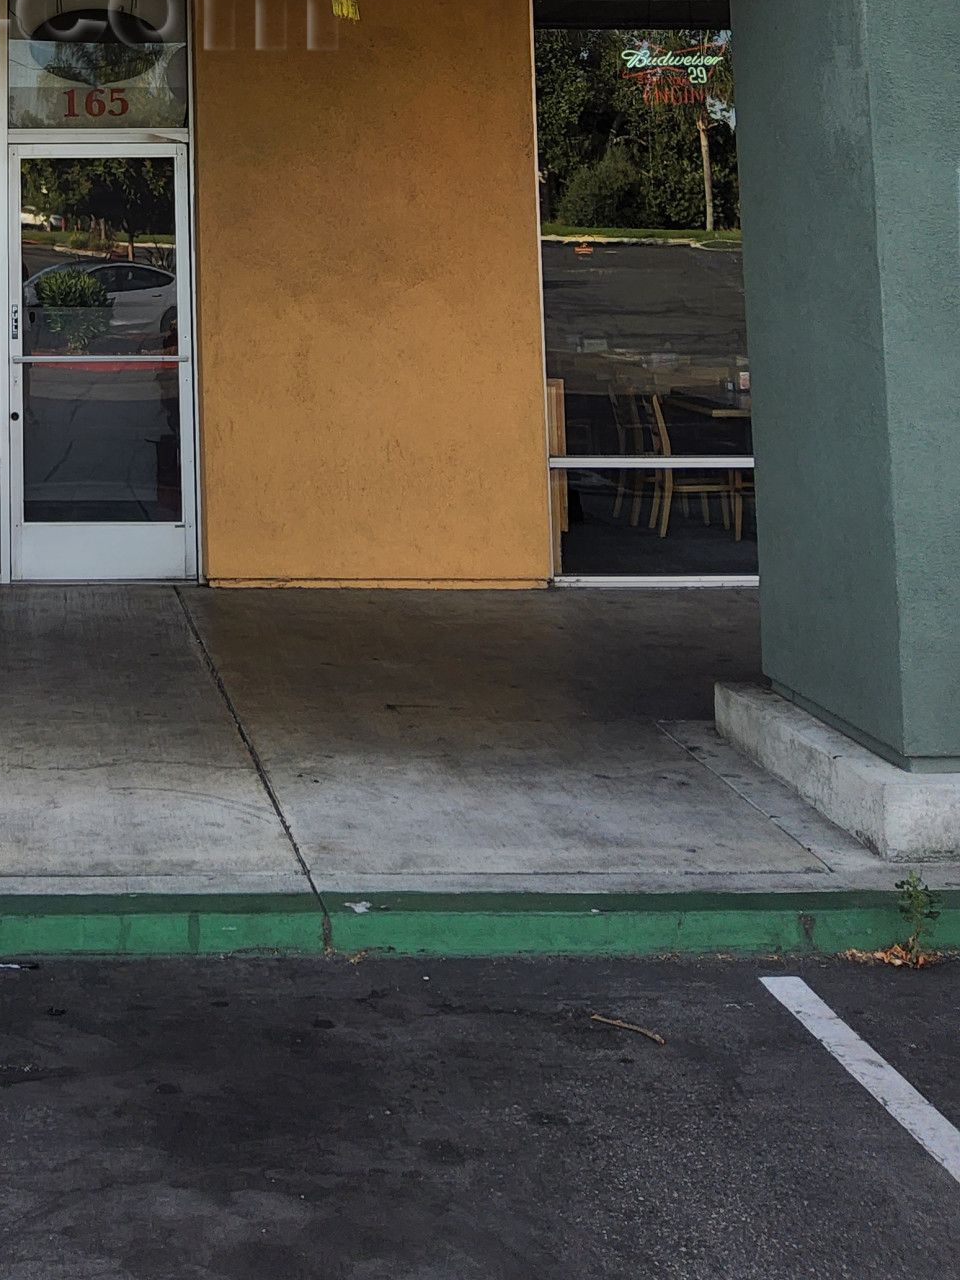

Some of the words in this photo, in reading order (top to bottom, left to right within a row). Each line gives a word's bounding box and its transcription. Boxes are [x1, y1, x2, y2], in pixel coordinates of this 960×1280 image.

[621, 50, 724, 69] Budweiser
[687, 66, 708, 84] 29
[63, 87, 130, 118] 165
